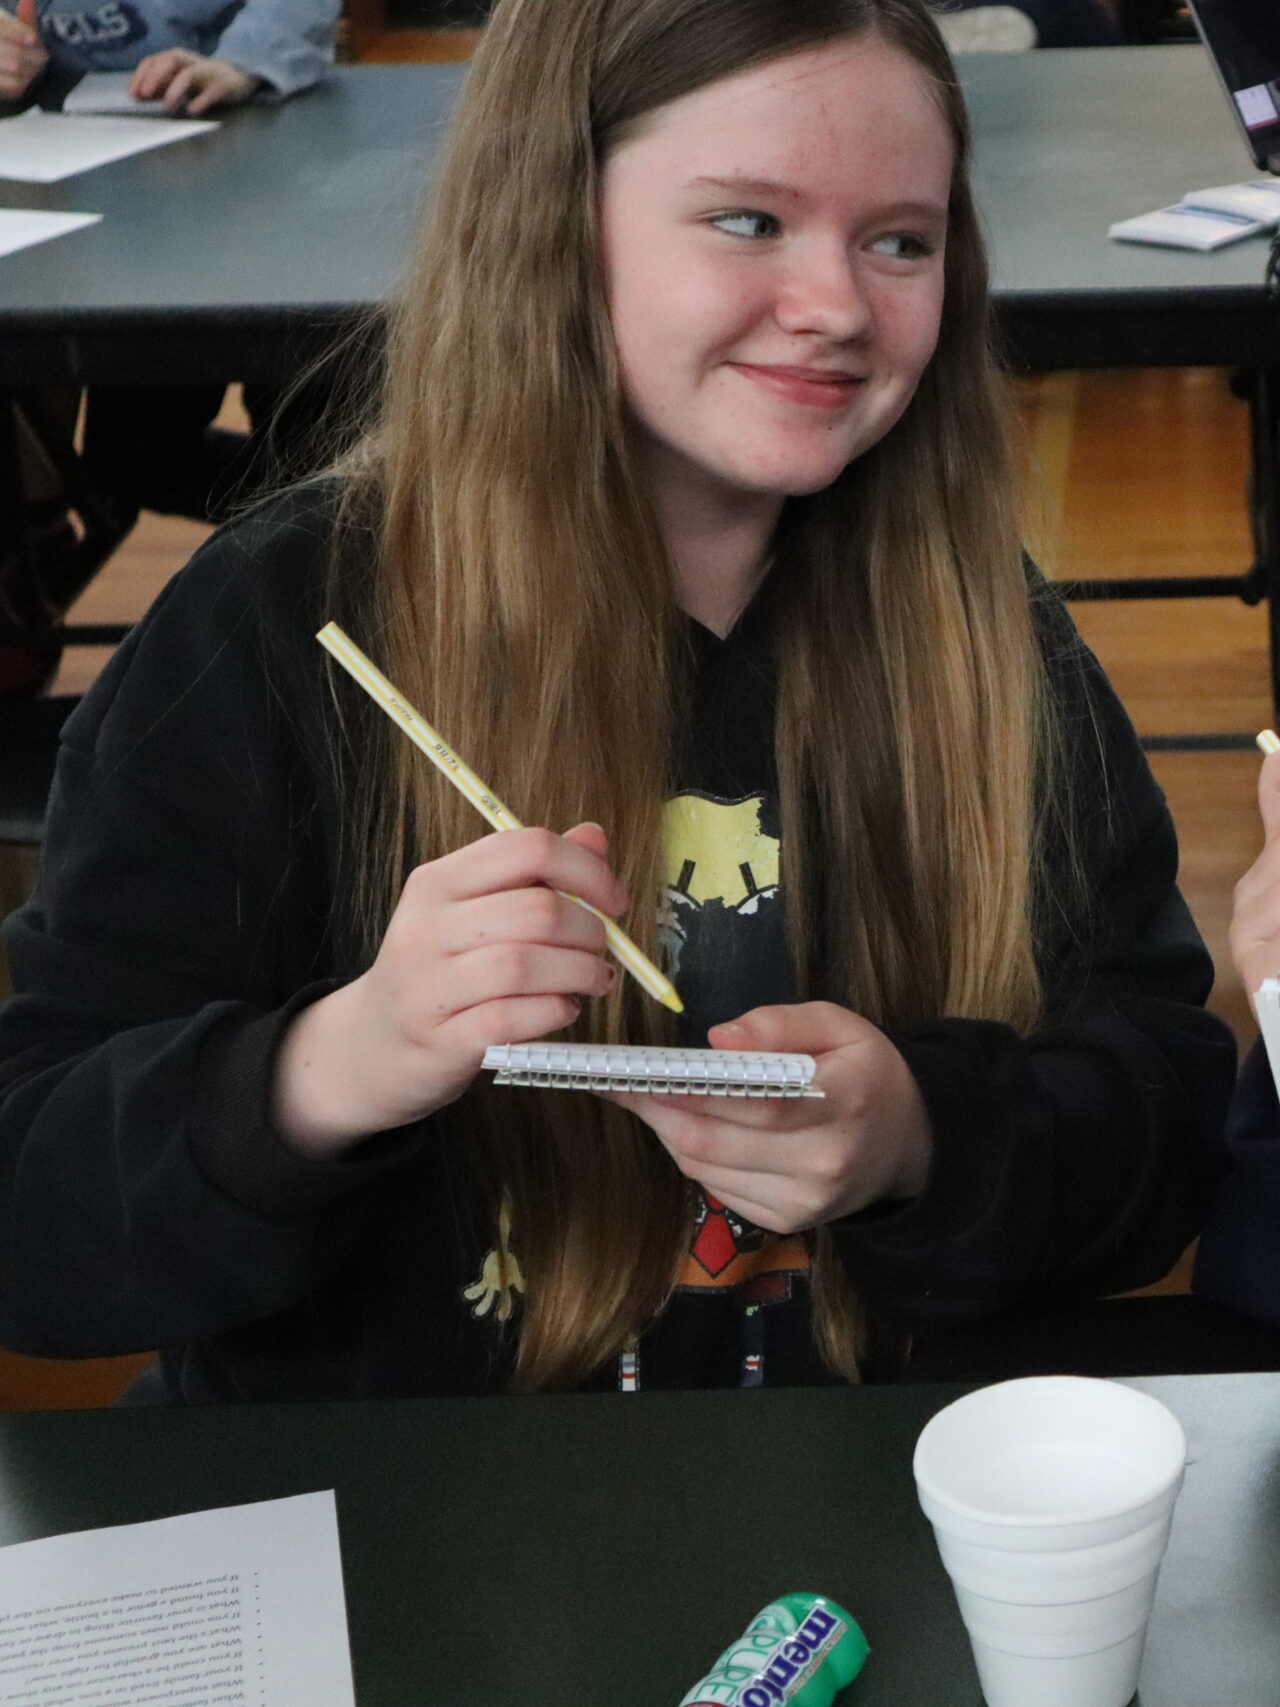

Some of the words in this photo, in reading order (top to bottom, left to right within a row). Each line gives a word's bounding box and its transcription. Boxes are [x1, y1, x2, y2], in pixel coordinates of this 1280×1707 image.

[206, 1574, 227, 1584] you
[160, 1580, 202, 1594] wanted
[206, 1586, 228, 1597] you
[231, 1586, 238, 1594] If
[110, 1591, 142, 1601] make
[170, 1592, 202, 1605] found
[53, 1597, 107, 1611] everyone
[126, 1599, 157, 1612] genie
[209, 1599, 239, 1609] What
[12, 1611, 32, 1619] the
[167, 1606, 192, 1617] your
[207, 1612, 228, 1622] you
[232, 1611, 239, 1619] If
[118, 1612, 162, 1626] favorite
[172, 1618, 204, 1630] could
[84, 1622, 113, 1632] thing
[140, 1625, 168, 1636] meet
[201, 1624, 240, 1636] What's
[33, 1631, 65, 1642] draw
[84, 1630, 136, 1645] someone
[152, 1637, 175, 1647] best
[103, 1640, 147, 1655] present
[188, 1644, 206, 1652] are
[211, 1637, 241, 1648] What
[29, 1647, 47, 1655] the
[78, 1649, 98, 1660] you
[163, 1646, 183, 1657] you
[209, 1651, 230, 1661] you
[234, 1650, 242, 1658] If
[48, 1655, 73, 1666] ever
[113, 1651, 159, 1668] grateful
[735, 1607, 839, 1707] mento
[94, 1662, 109, 1670] for
[155, 1664, 169, 1672] be
[173, 1657, 205, 1670] could
[234, 1664, 242, 1672] If
[694, 1633, 781, 1703] PURE
[61, 1666, 88, 1677] right
[204, 1665, 231, 1677] your
[85, 1670, 142, 1685] character
[163, 1672, 199, 1685] family
[130, 1680, 159, 1692] lived
[212, 1678, 243, 1689] What
[136, 1684, 208, 1703] superpower
[212, 1691, 244, 1703] What
